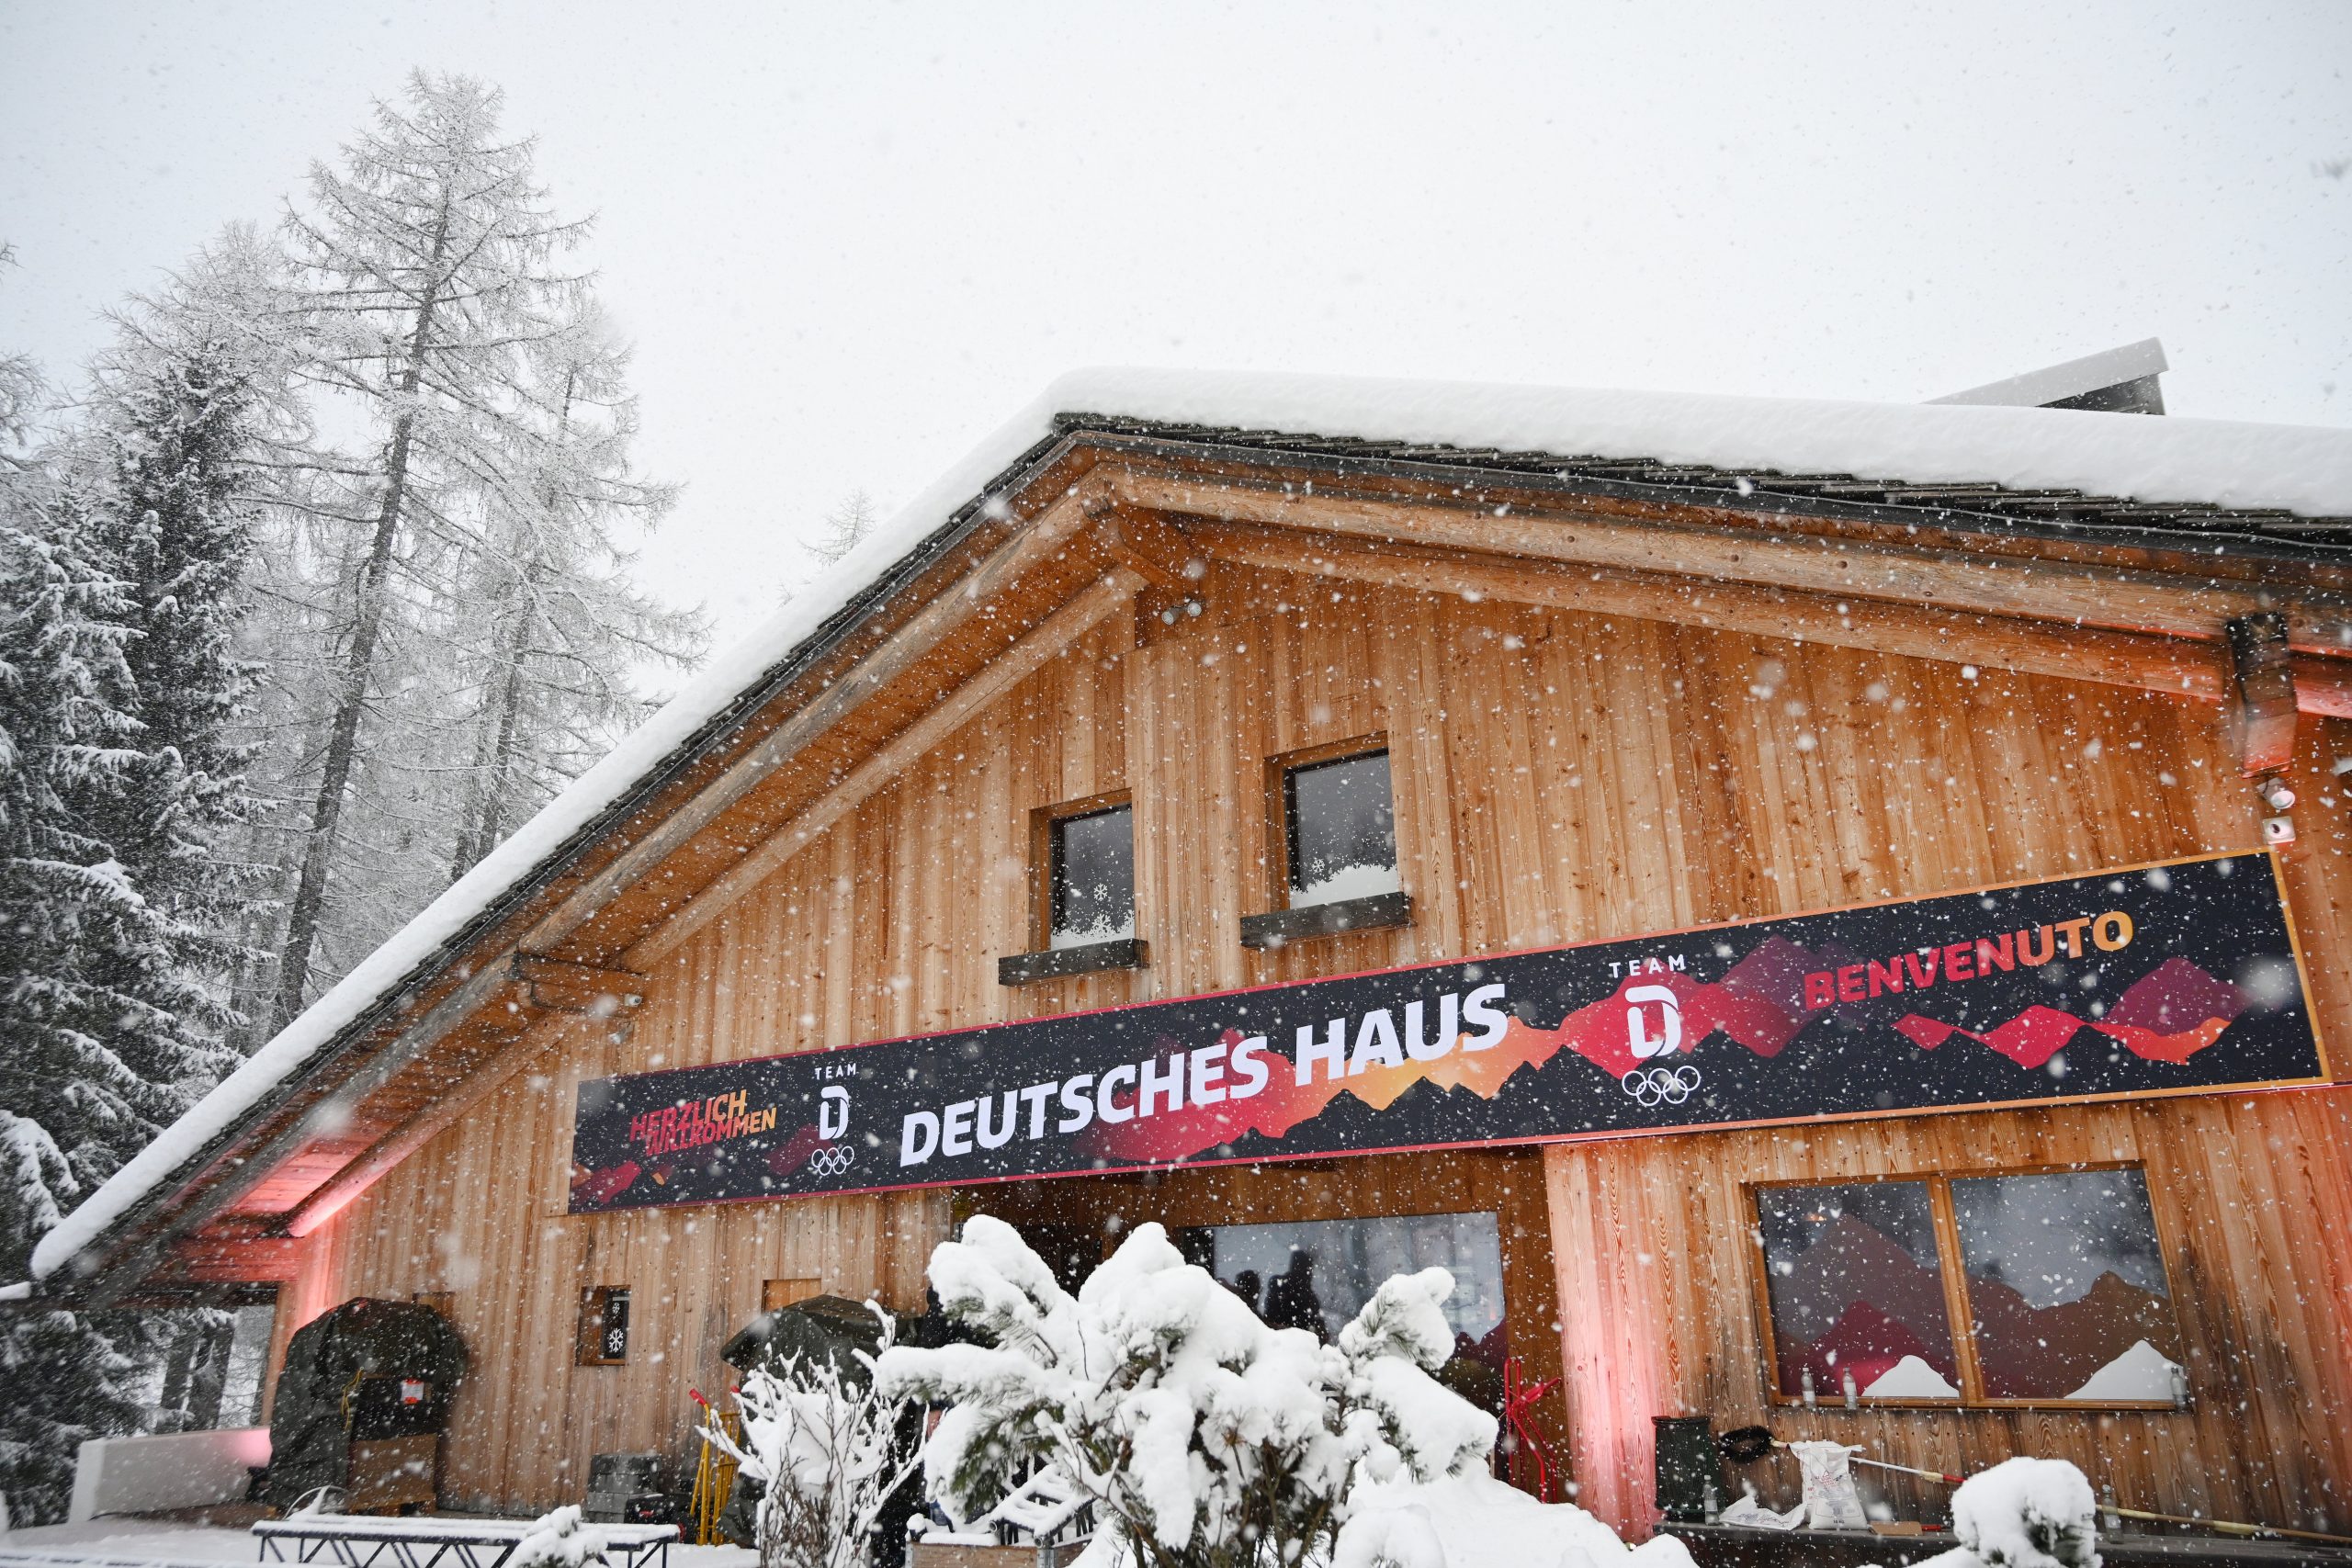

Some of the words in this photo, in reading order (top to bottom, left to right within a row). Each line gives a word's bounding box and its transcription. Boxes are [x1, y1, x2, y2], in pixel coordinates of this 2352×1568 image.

[1609, 954, 1685, 978] TEAM
[1804, 910, 2134, 1011] BENVENUTO
[815, 1063, 856, 1080] TEAM
[899, 1037, 1269, 1168] DEUTSCHES
[1295, 984, 1510, 1086] HAUS
[629, 1089, 747, 1142] HERZLICH
[646, 1107, 776, 1156] WILLKOMMEN
